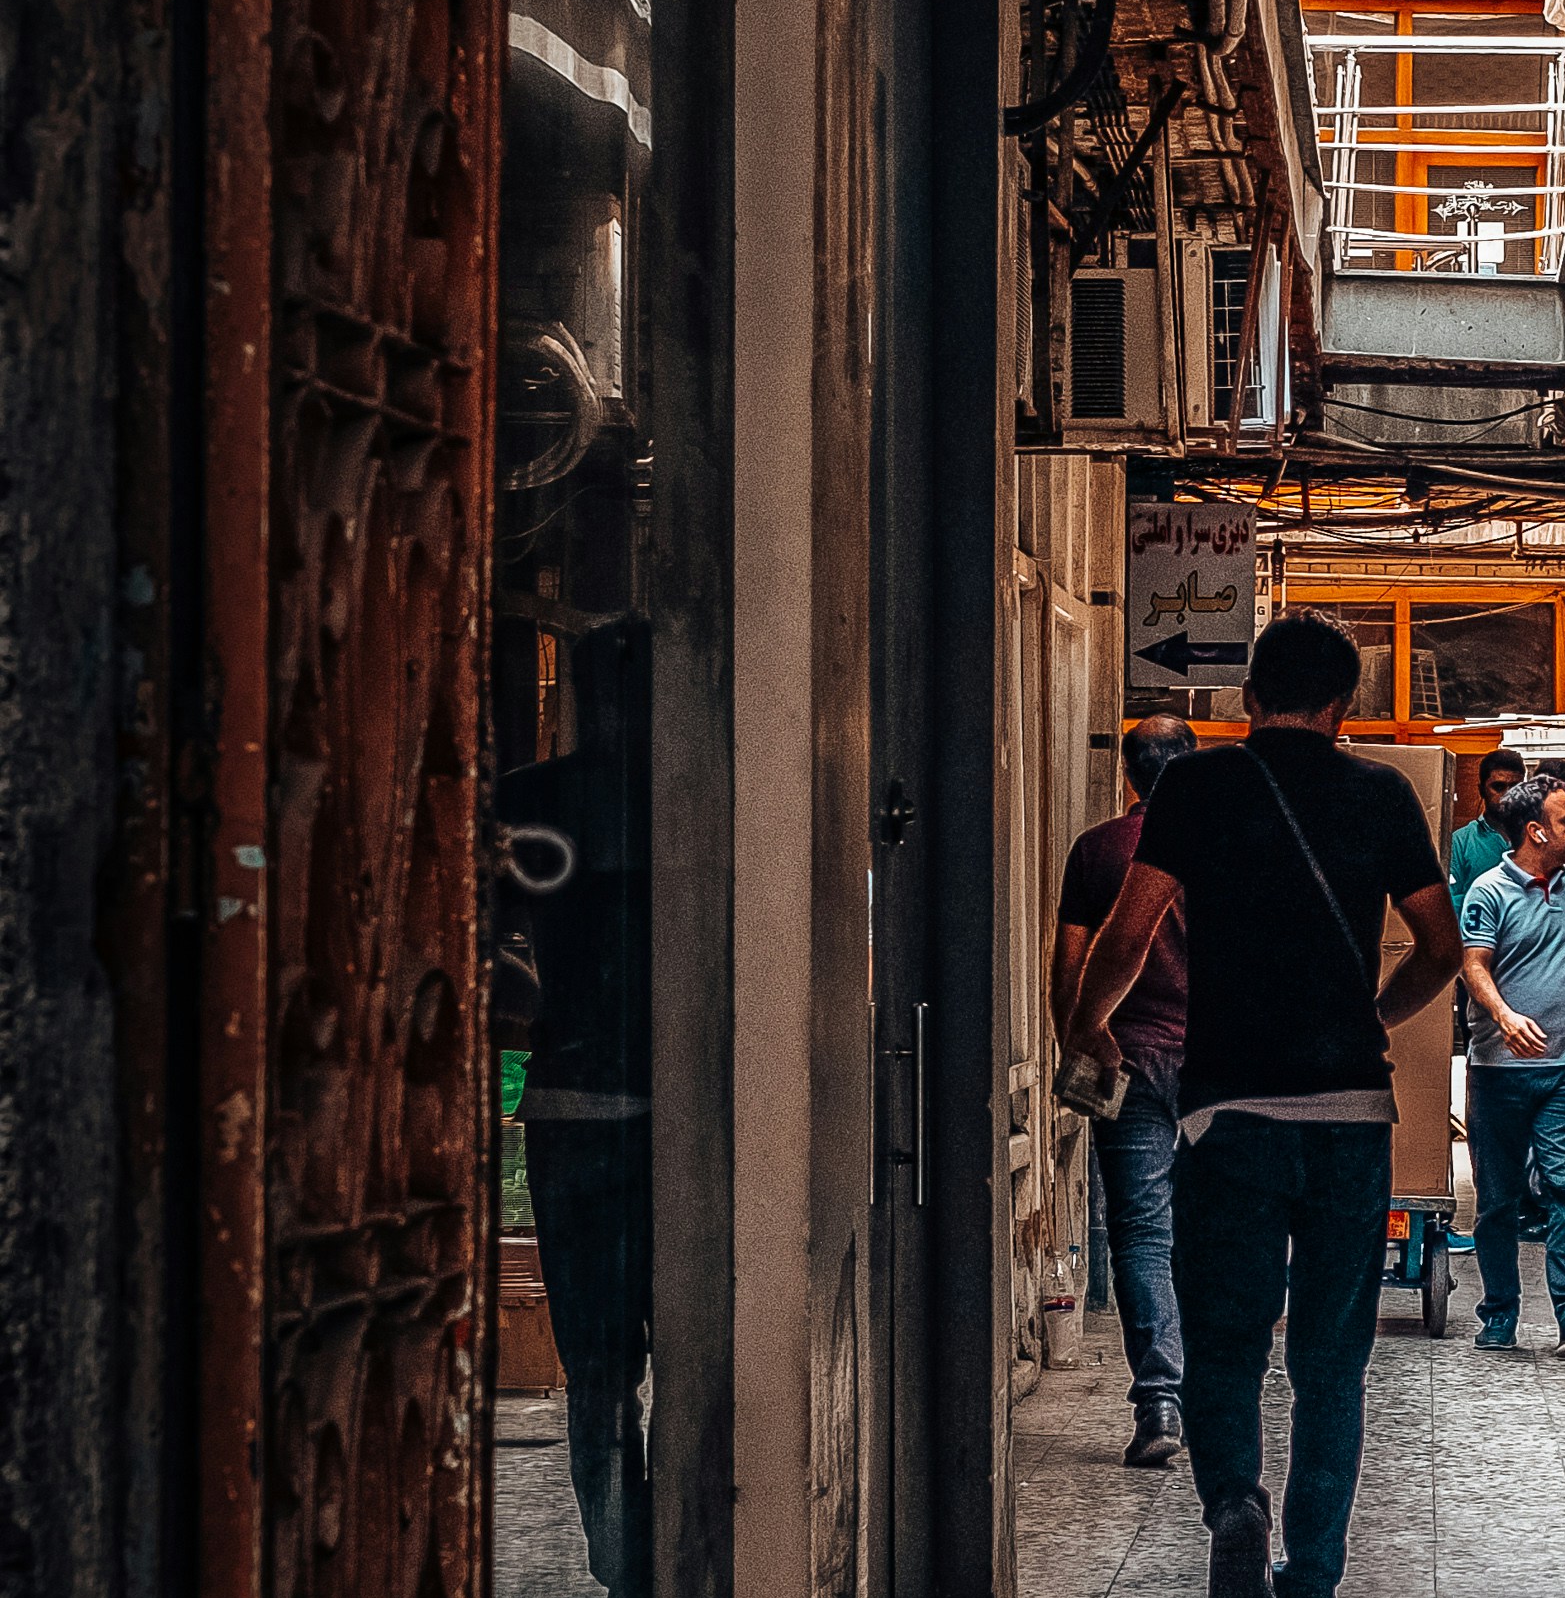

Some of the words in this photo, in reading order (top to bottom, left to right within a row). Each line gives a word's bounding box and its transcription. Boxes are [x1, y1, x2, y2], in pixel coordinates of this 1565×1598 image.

[1175, 525, 1184, 555] و
[1187, 511, 1211, 555] سرا
[1213, 518, 1250, 555] دیزی
[1142, 570, 1238, 626] صابر
[1465, 903, 1482, 931] 3
